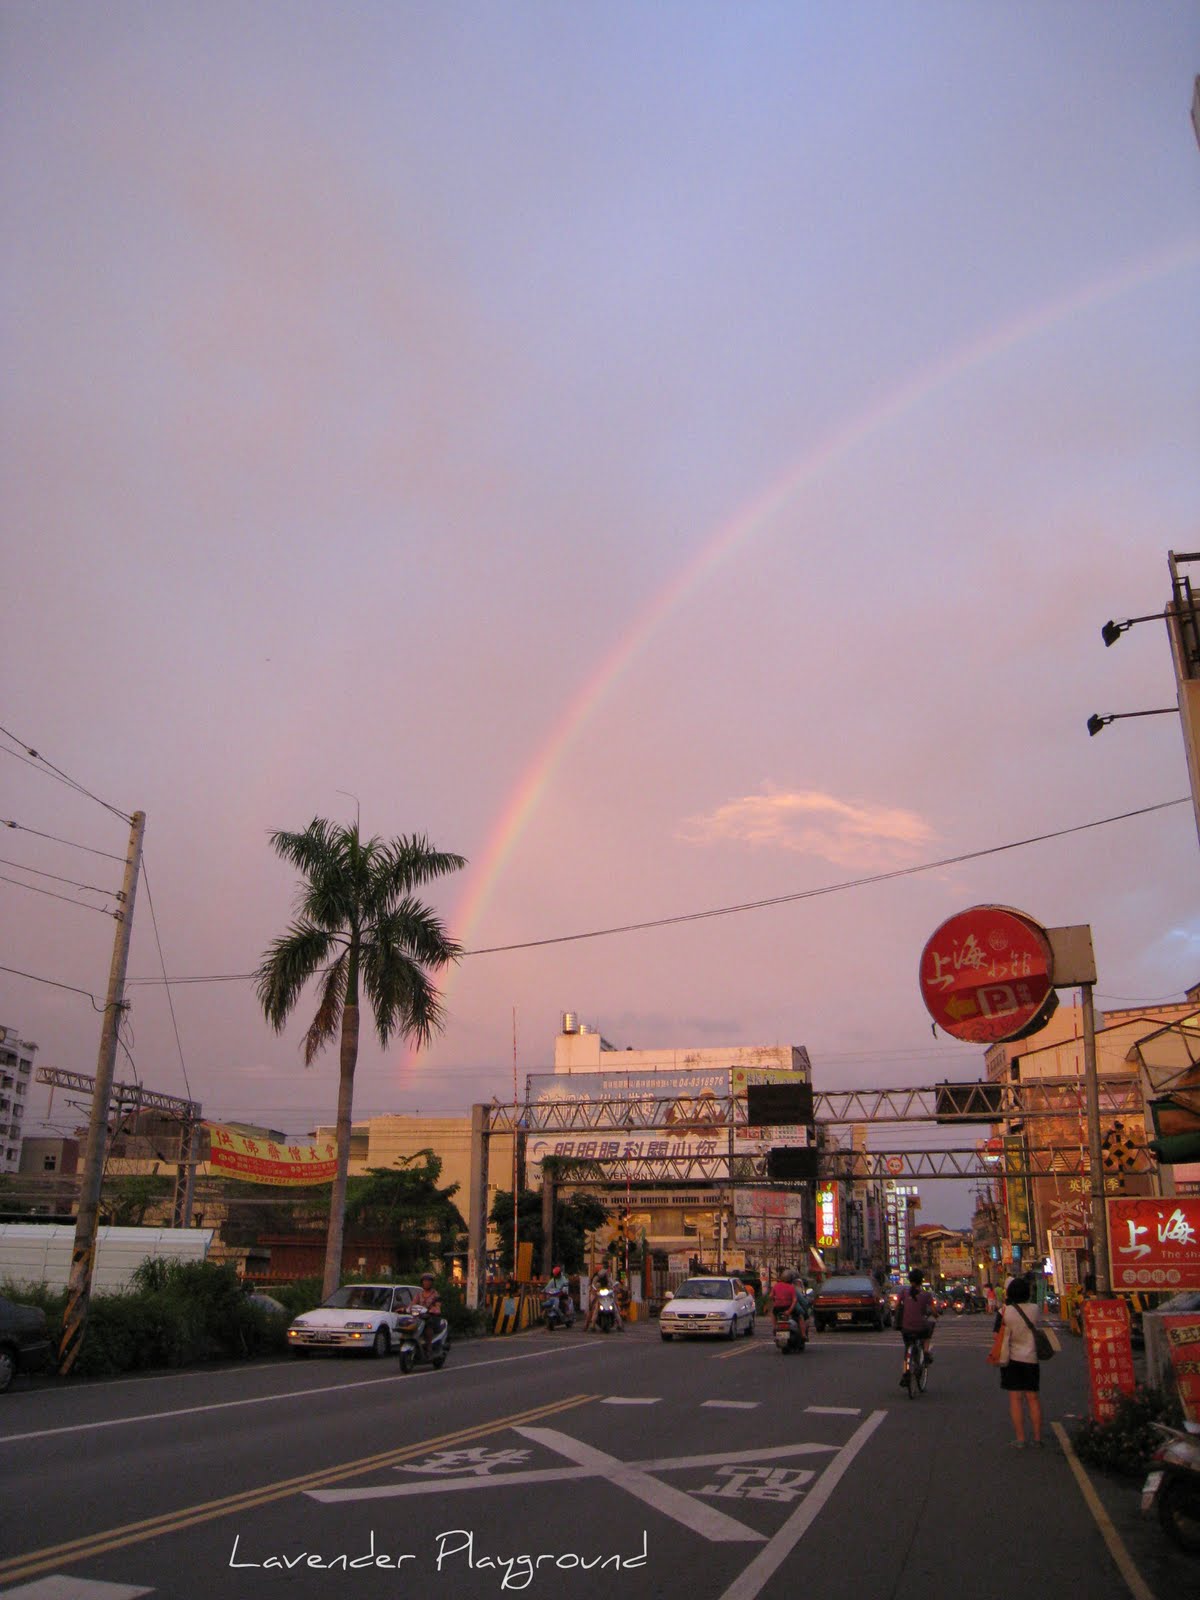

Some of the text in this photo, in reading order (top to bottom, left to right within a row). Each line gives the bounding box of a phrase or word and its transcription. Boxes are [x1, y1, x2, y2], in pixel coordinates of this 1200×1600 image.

[1118, 1208, 1197, 1260] 上海
[818, 1236, 833, 1246] 40
[1161, 1250, 1181, 1259] The
